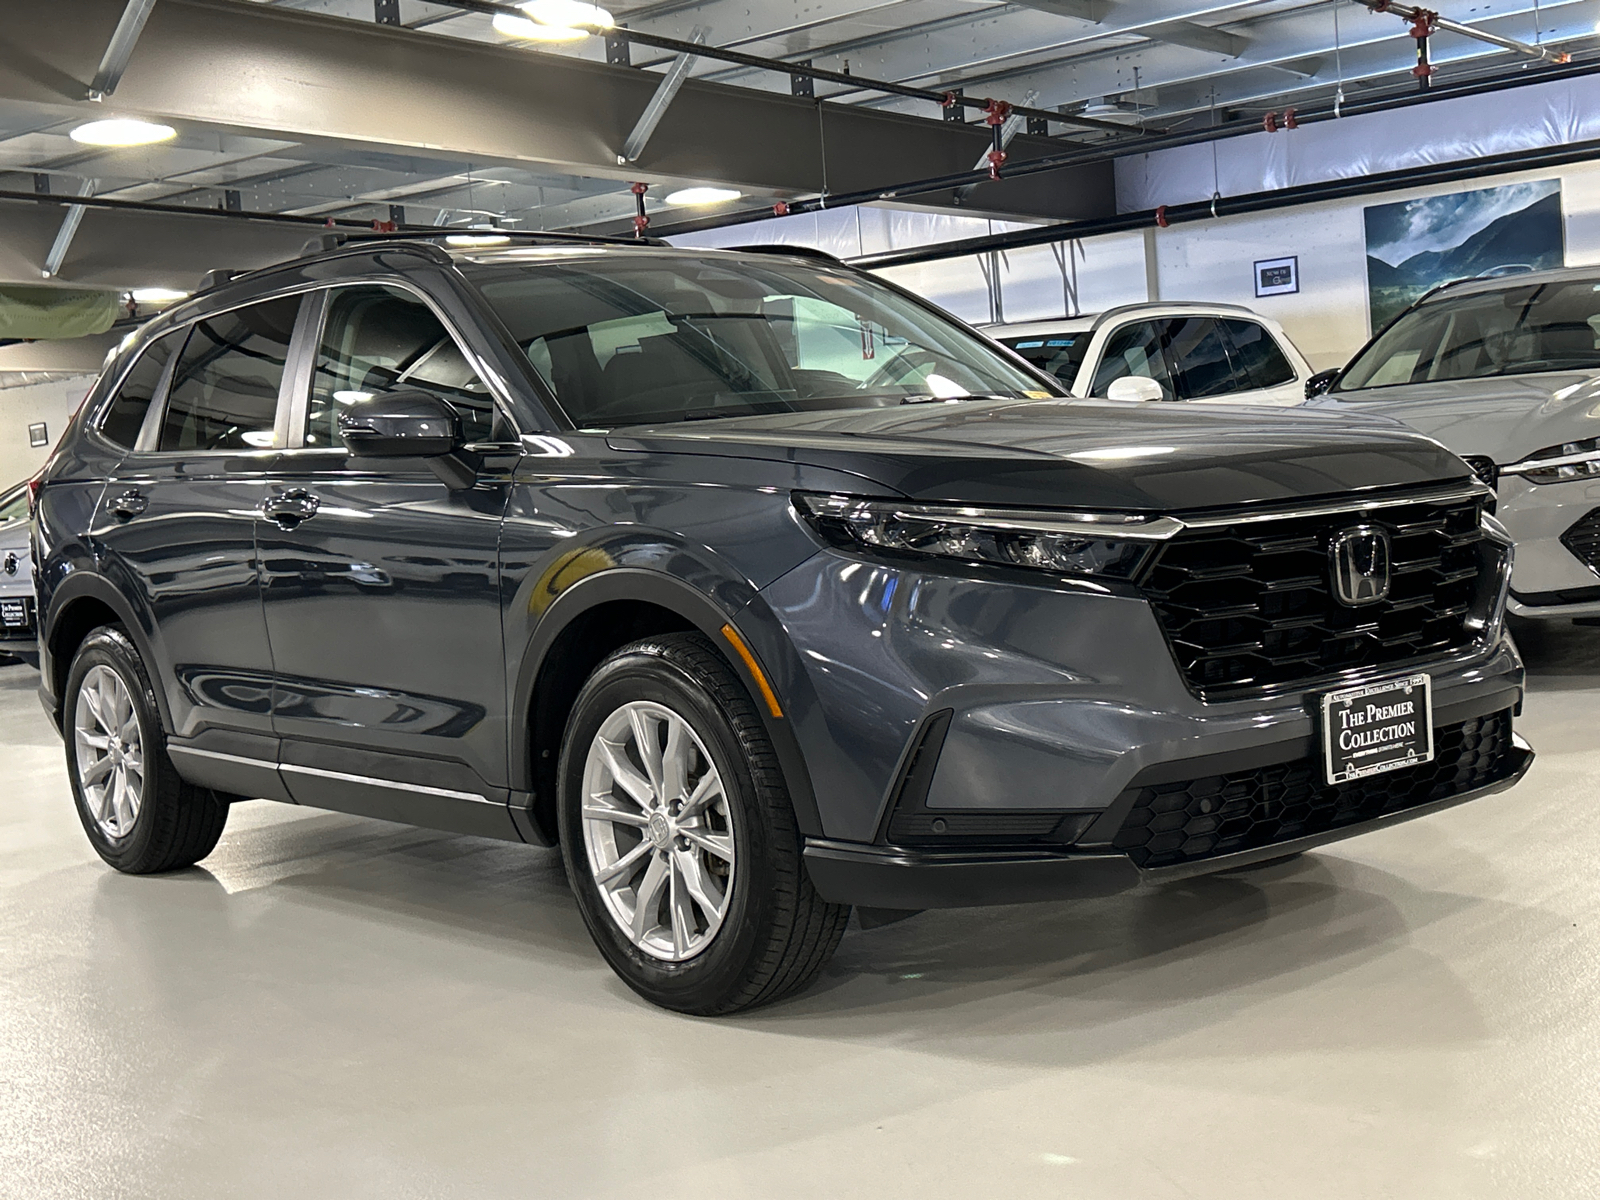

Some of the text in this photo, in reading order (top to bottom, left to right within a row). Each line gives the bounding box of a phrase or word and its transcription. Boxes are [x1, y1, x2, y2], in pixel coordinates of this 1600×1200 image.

[1339, 701, 1414, 729] THE PREMIER
[1339, 721, 1415, 750] COLLECTION
